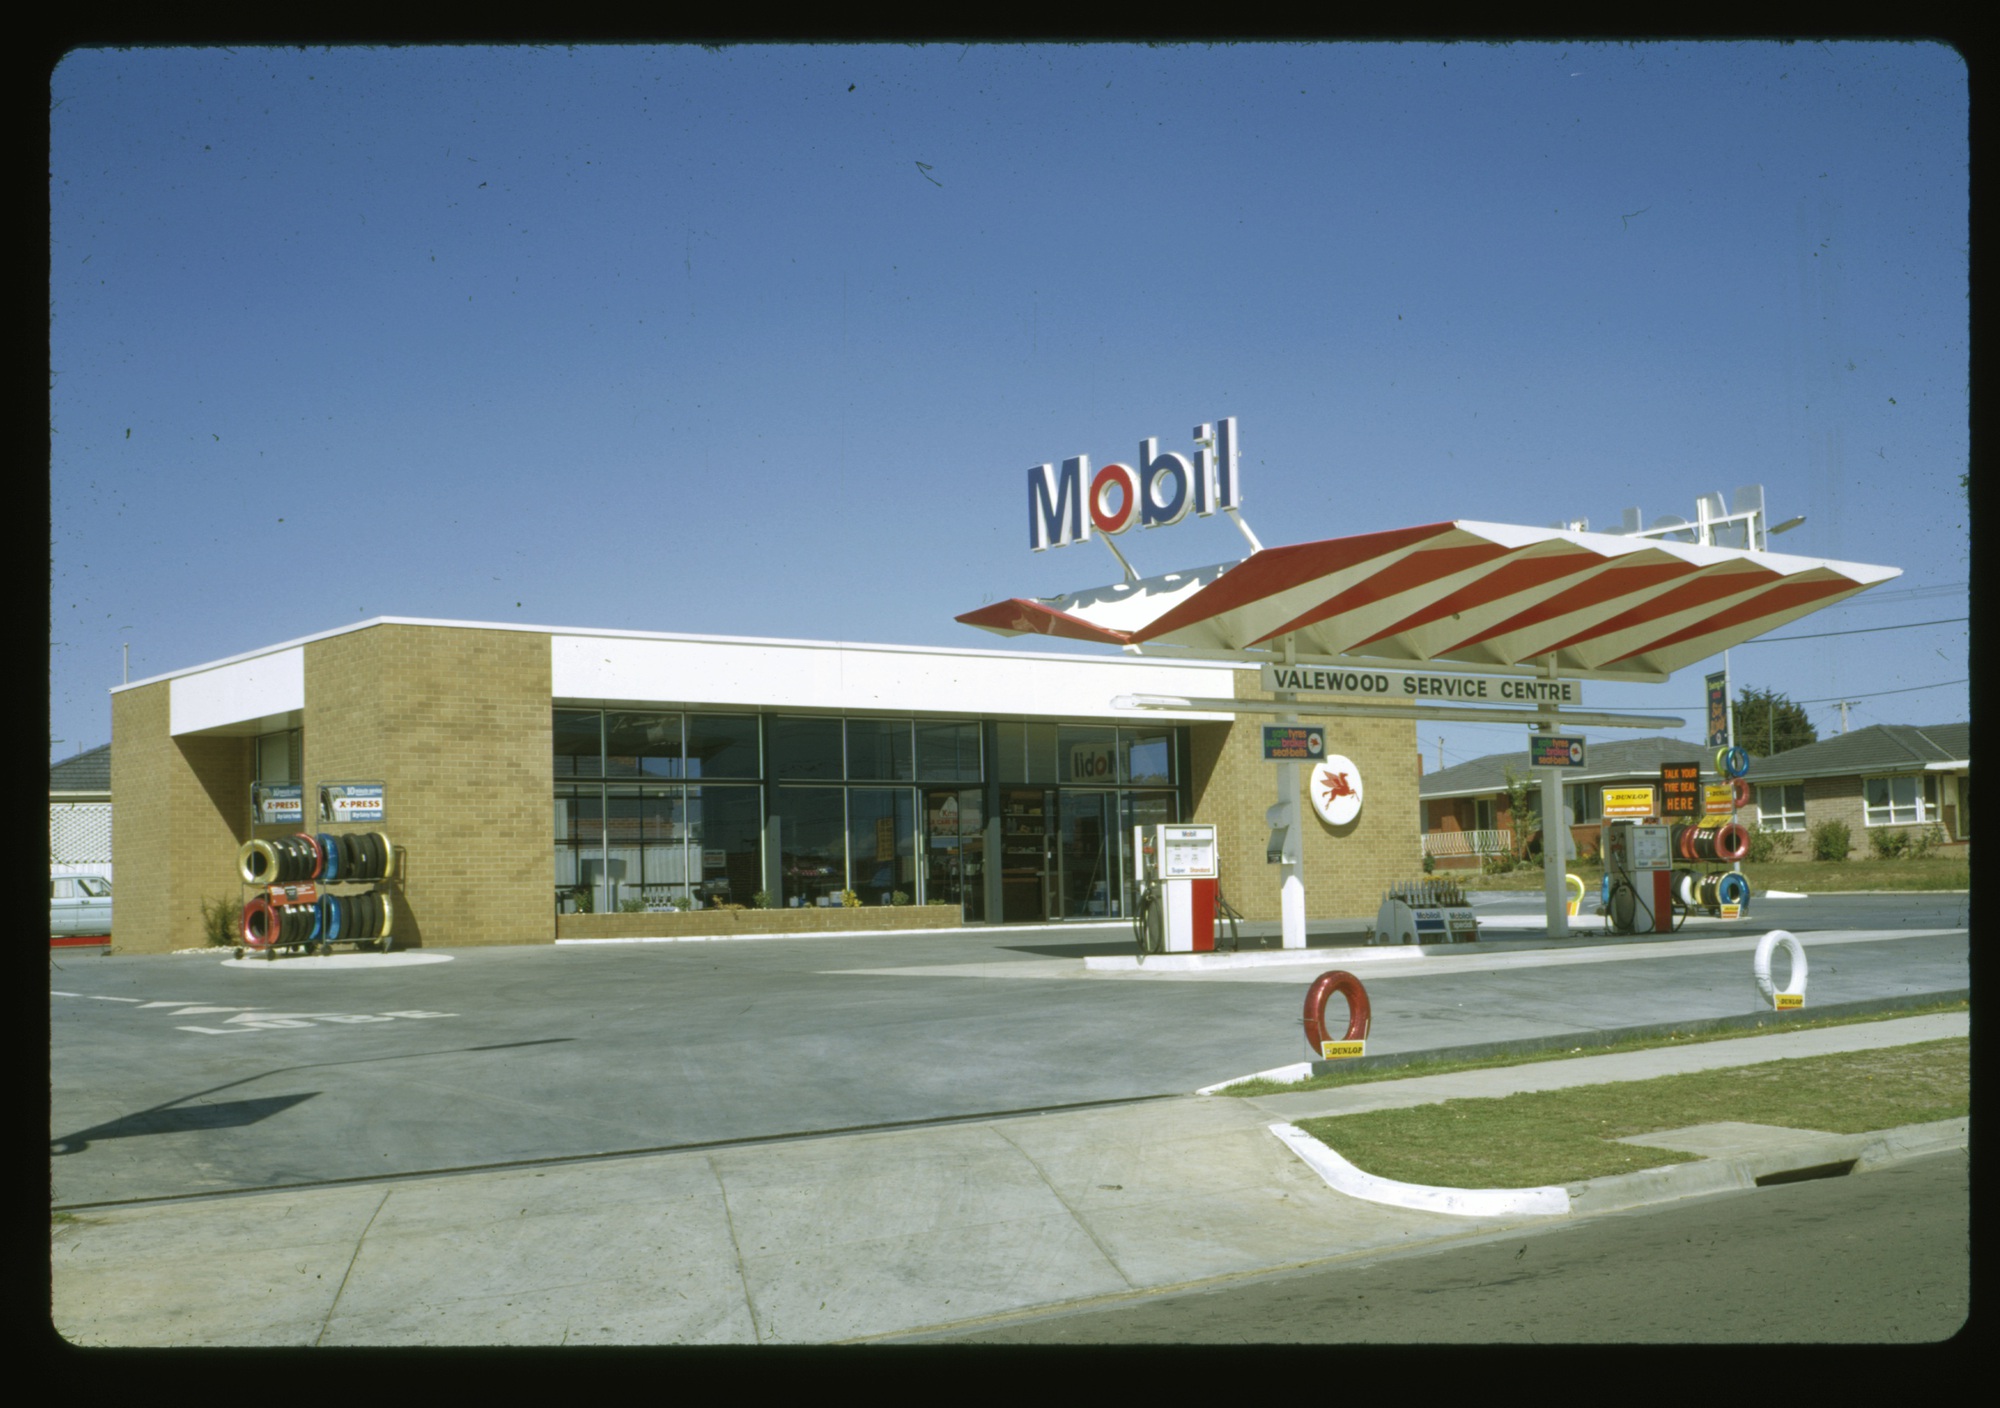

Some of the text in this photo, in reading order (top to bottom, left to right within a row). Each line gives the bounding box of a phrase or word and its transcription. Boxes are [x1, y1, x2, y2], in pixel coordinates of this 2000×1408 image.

[1028, 416, 1238, 553] Mobil
[1274, 669, 1571, 701] VALEWOOD SERVICE CENTRE
[1288, 728, 1307, 739] tyres
[1281, 738, 1307, 748] brakes
[1546, 746, 1569, 756] brakes
[1664, 768, 1697, 779] TALK YOUR
[347, 786, 355, 796] 10
[1664, 782, 1696, 792] TYRE DEAL
[267, 801, 299, 810] X-PRESS
[339, 800, 380, 808] X-PRESS
[1667, 797, 1694, 811] HERE
[1332, 1047, 1363, 1055] DUNLOP
